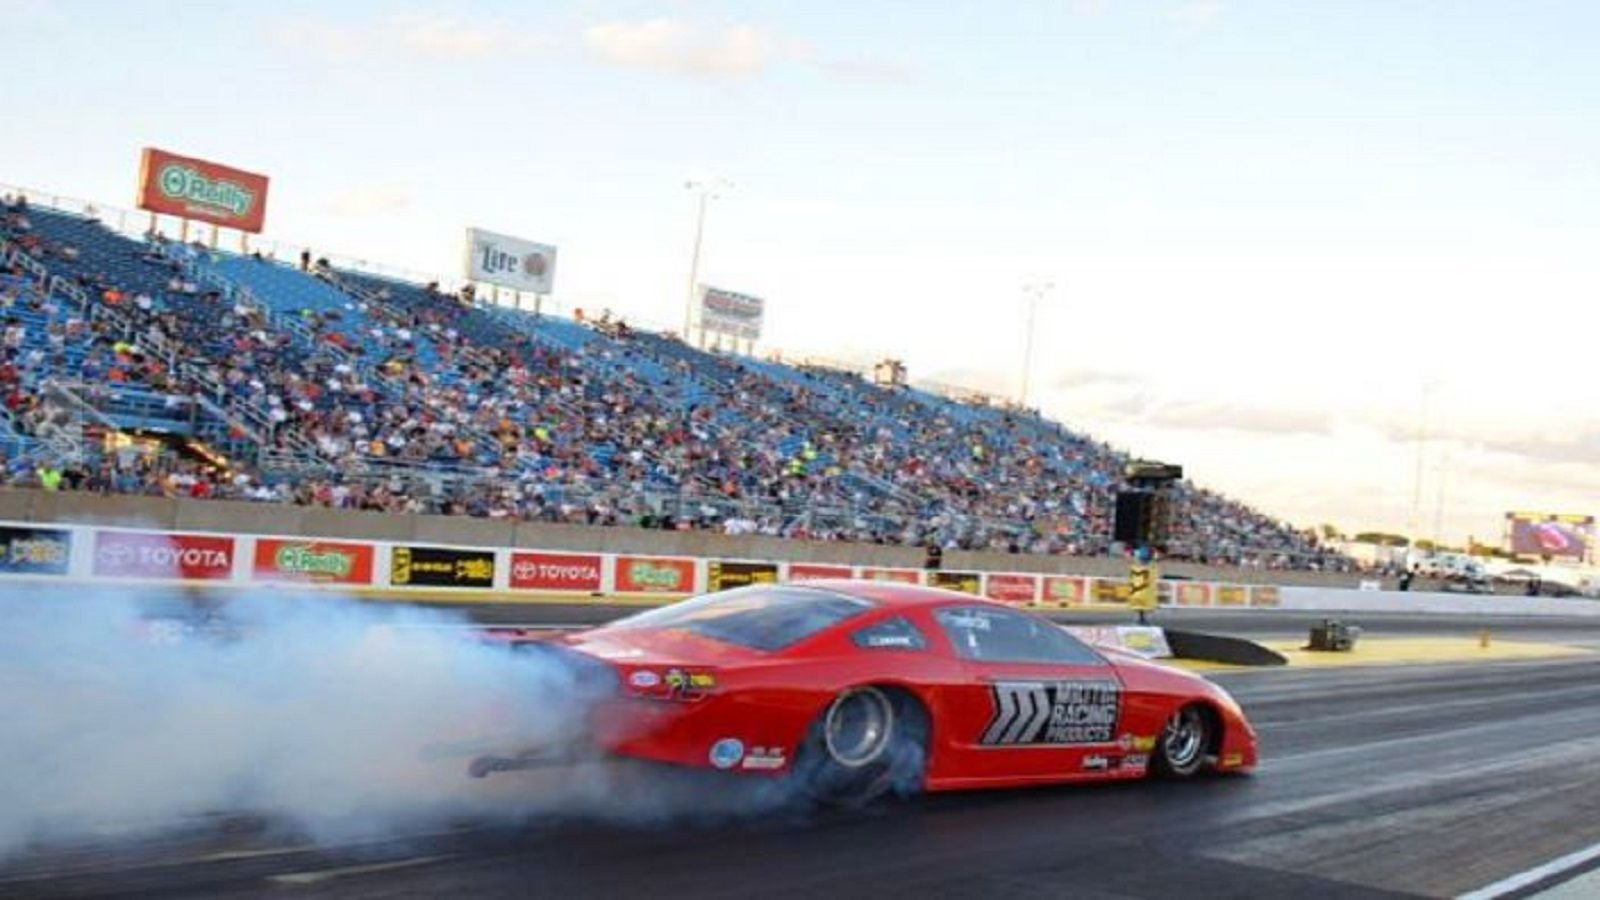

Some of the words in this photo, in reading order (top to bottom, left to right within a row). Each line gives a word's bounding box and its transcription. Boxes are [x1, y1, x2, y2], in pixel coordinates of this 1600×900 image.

[482, 246, 518, 274] Lite
[140, 548, 228, 567] TOYOTA
[539, 563, 600, 579] TOYOTA
